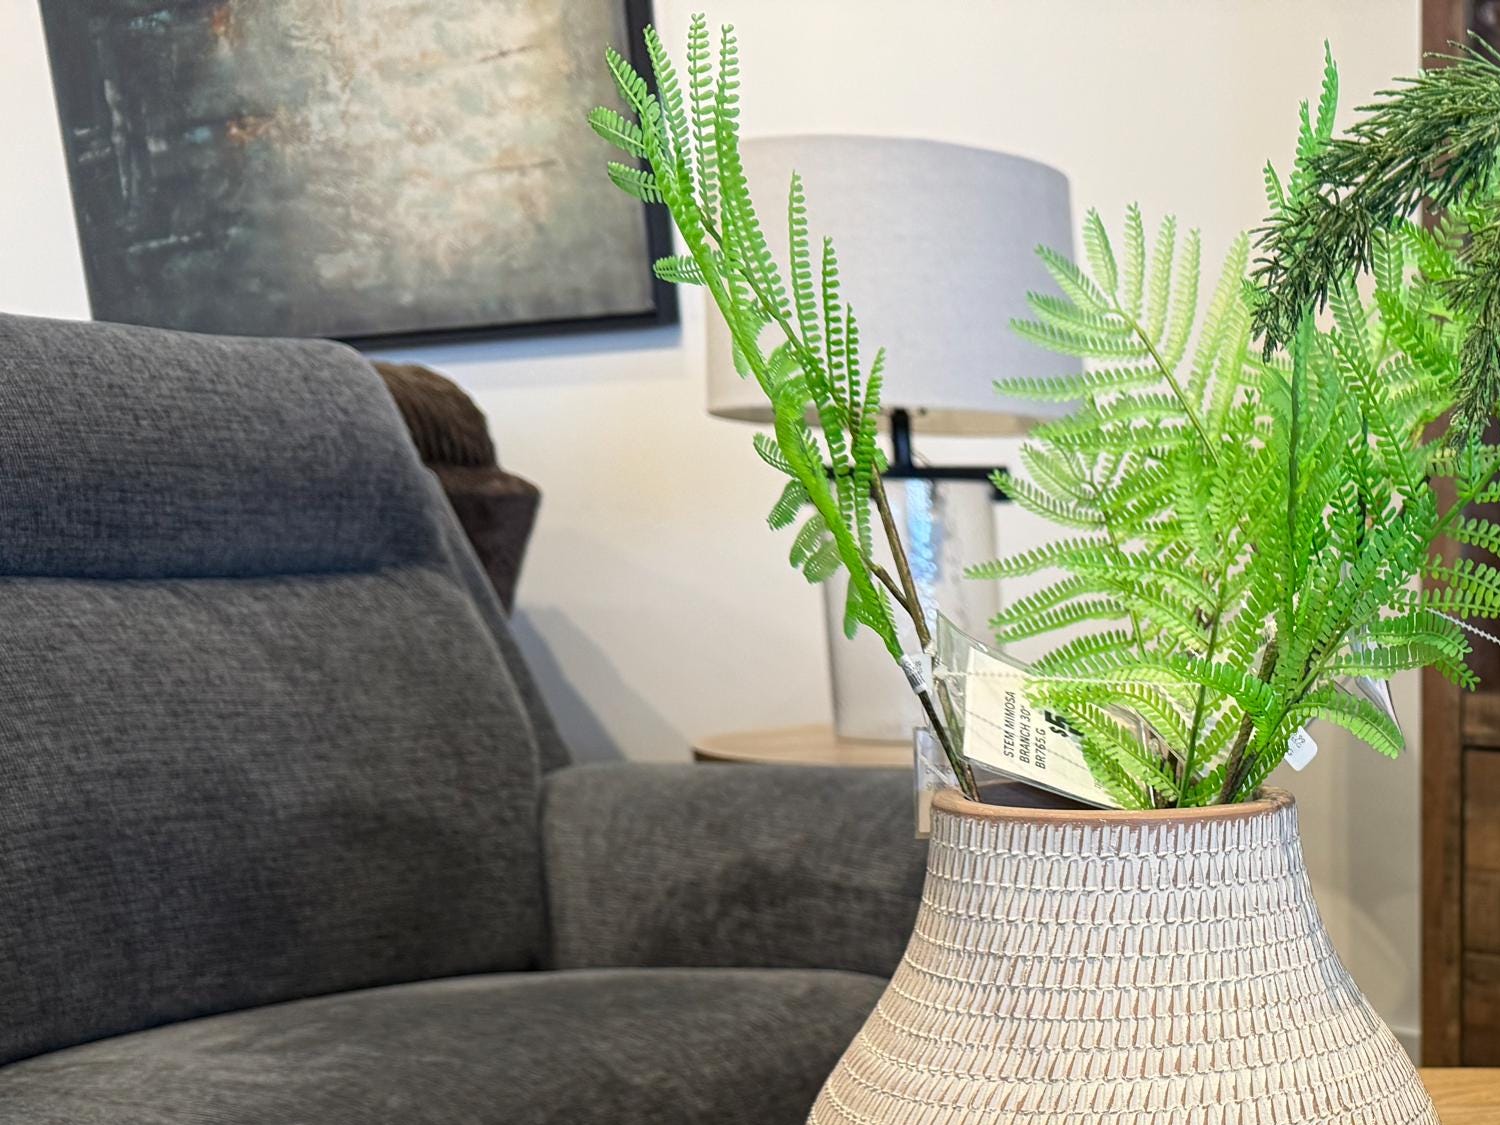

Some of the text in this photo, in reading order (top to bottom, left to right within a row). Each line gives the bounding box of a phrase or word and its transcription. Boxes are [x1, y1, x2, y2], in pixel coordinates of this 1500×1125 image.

[1003, 691, 1017, 759] STEM MIMOSA
[1019, 722, 1032, 764] BRANCH
[1034, 728, 1047, 770] BR765.G
